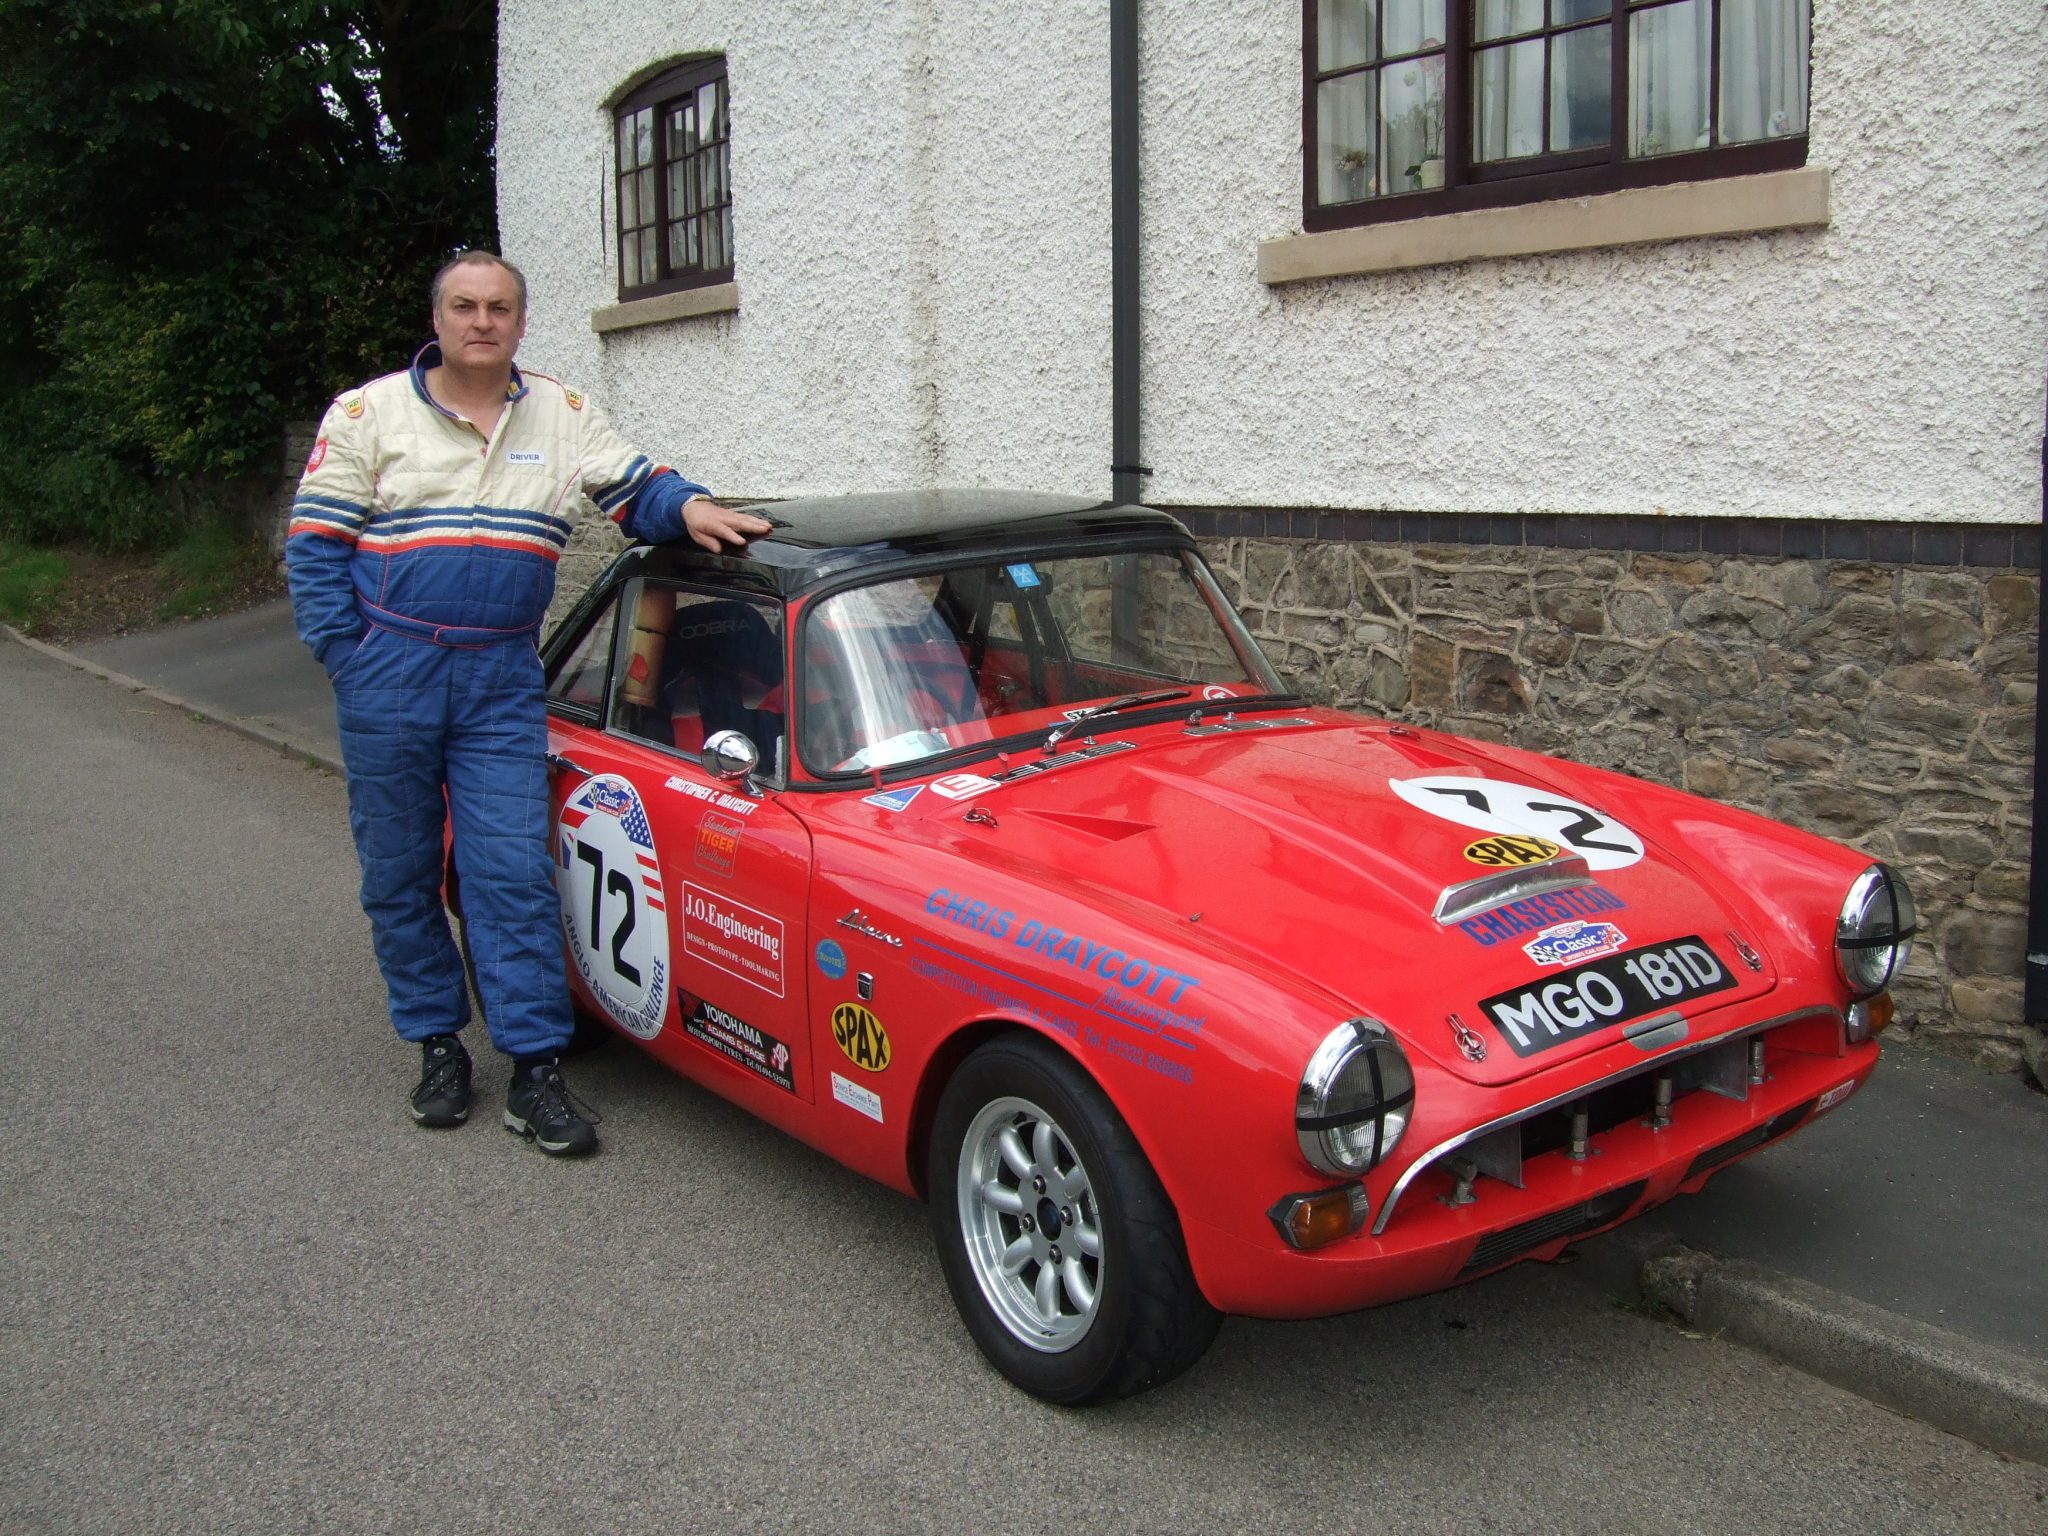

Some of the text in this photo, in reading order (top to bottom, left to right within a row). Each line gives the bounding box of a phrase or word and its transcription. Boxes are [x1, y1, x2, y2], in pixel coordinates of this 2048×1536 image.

[510, 453, 540, 461] DRIVER
[679, 618, 751, 640] COBRA
[599, 790, 621, 808] Classic
[664, 776, 713, 799] CHRISTOPHER
[716, 793, 759, 815] DRAYCOTT
[700, 829, 735, 853] TIGER
[1420, 786, 1640, 856] 72
[1467, 836, 1557, 864] SPAX
[577, 839, 642, 988] 72
[686, 894, 779, 960] J.O.Engineering
[1459, 886, 1626, 946] CHASESTEAD
[686, 932, 780, 982] DESIGN PROTOTYPE TOOLMAKING
[924, 887, 1200, 1005] CHRIS DRAYCOTT
[1553, 934, 1601, 955] Classic
[564, 913, 665, 1033] ANGLO AMERICAN CHALLENGE
[1491, 944, 1722, 1047] MGO 181D
[911, 957, 978, 997] COMPETITION
[1041, 1010, 1078, 1040] CARS
[1090, 986, 1206, 1034] Motorsport
[703, 1002, 764, 1048] YOKOHAMA
[706, 1024, 736, 1046] ADAMS
[743, 1044, 766, 1064] PAGE
[834, 1006, 887, 1069] SPAX
